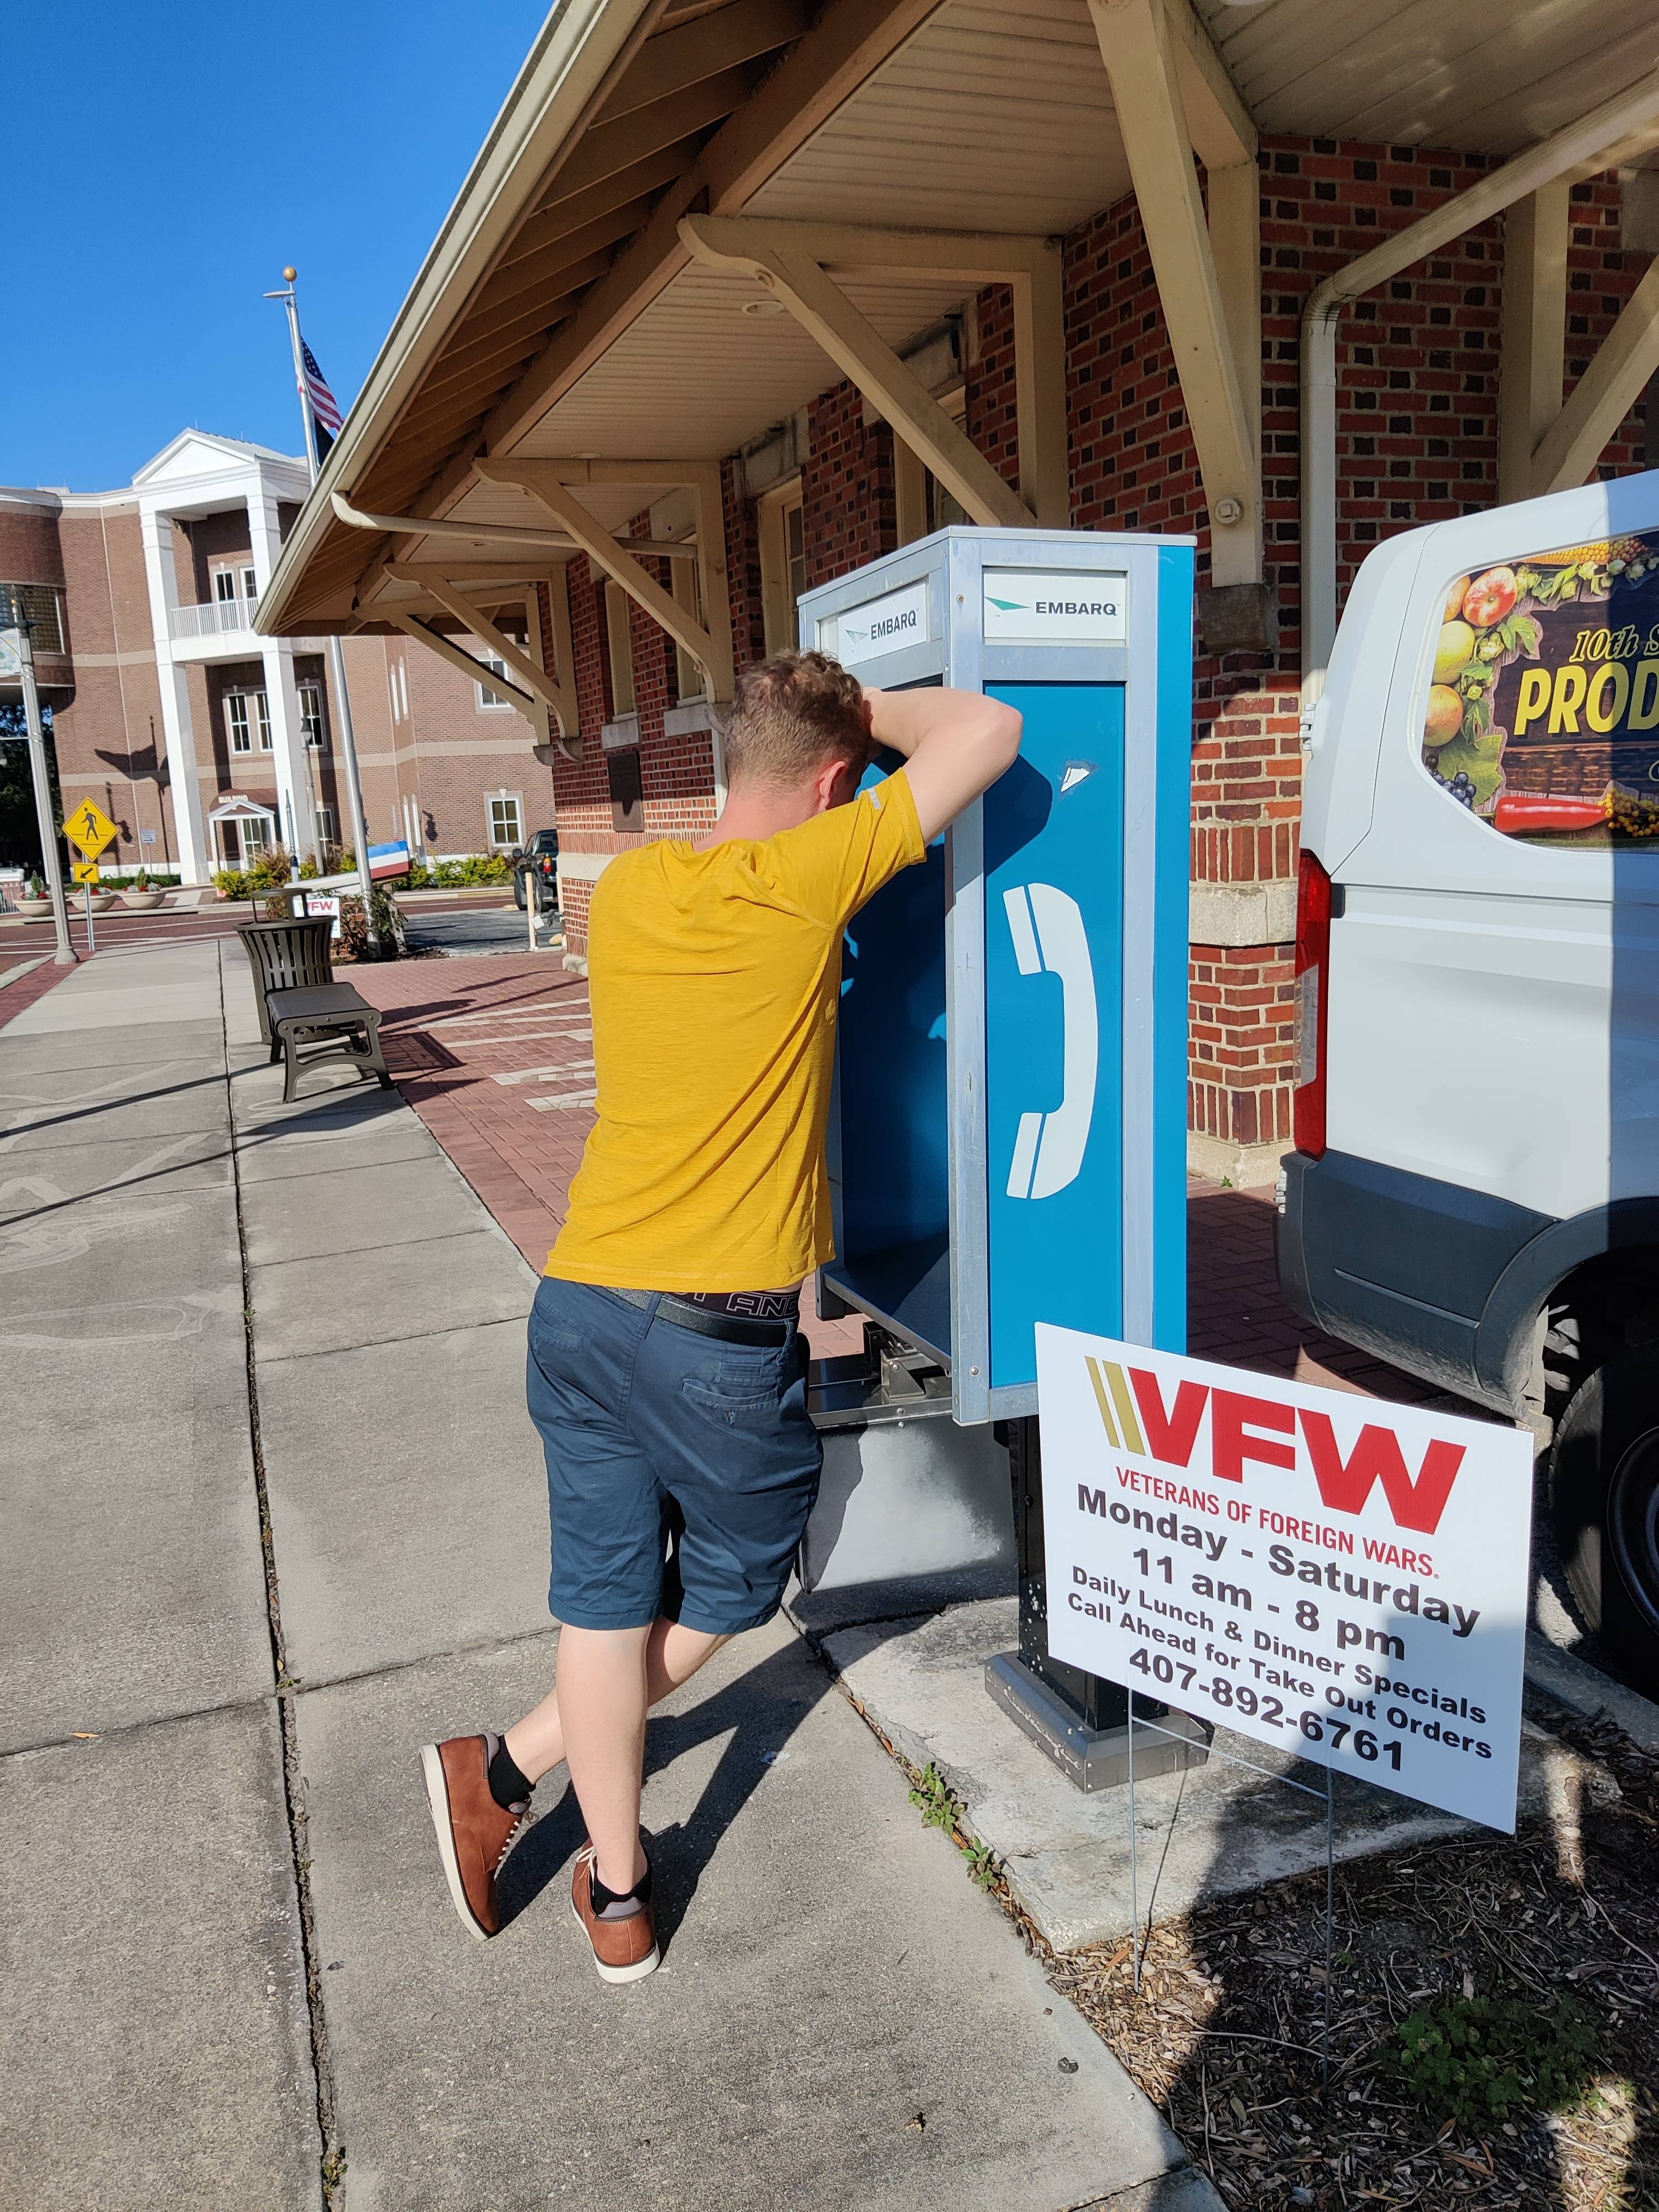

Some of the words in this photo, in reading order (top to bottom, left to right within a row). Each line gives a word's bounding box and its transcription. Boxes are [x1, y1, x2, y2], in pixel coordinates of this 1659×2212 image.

[870, 609, 917, 641] EMBARQ
[1035, 601, 1118, 617] EMBARQ
[1568, 624, 1639, 662] 10th
[307, 901, 333, 911] FW
[1128, 1366, 1467, 1536] VFW
[1077, 1483, 1228, 1562] Monday
[1267, 1544, 1481, 1639] Saturday
[1116, 1465, 1220, 1516] VETERANS
[1227, 1500, 1252, 1524] OF
[1259, 1508, 1353, 1555] FOREIGN
[1072, 1565, 1131, 1605] Daily
[1139, 1589, 1214, 1634] Lunch
[1224, 1620, 1244, 1643] &
[1254, 1629, 1346, 1677] Dinner
[1354, 1663, 1486, 1724] Specials
[1133, 1547, 1173, 1585] 11
[1191, 1573, 1253, 1613] am
[1295, 1599, 1320, 1632] 8
[1336, 1618, 1405, 1661] pm
[1067, 1592, 1112, 1624] Call
[1119, 1611, 1196, 1656] Ahead
[1204, 1642, 1241, 1671] for
[1249, 1657, 1316, 1698] Take
[1324, 1686, 1377, 1721] Out
[1386, 1707, 1493, 1760] Orders
[1129, 1647, 1402, 1772] 407-892-6761
